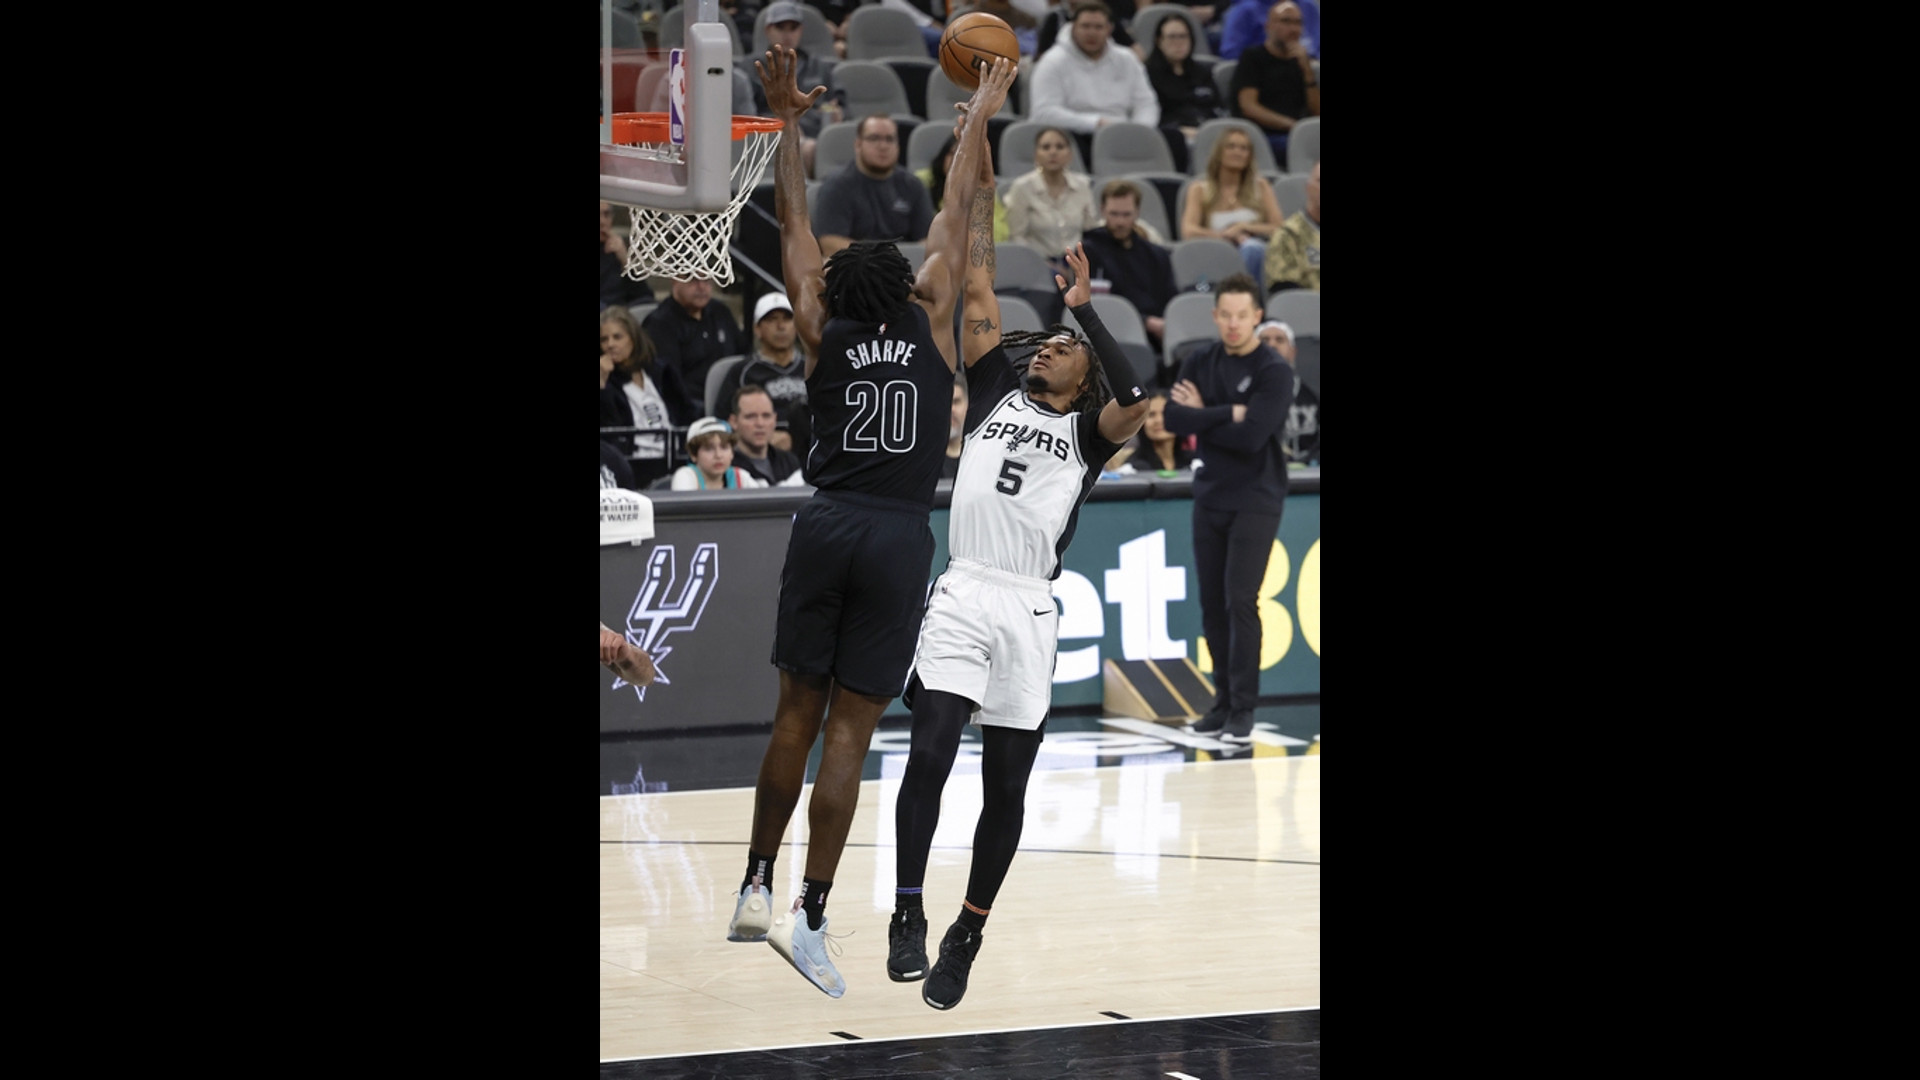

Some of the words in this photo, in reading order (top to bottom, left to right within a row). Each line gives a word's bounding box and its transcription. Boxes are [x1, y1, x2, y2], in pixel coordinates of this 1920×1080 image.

[845, 339, 917, 370] SHARPE
[843, 380, 918, 453] 20
[982, 422, 1070, 462] SPURS
[995, 458, 1028, 496] 5
[607, 513, 638, 522] WATER
